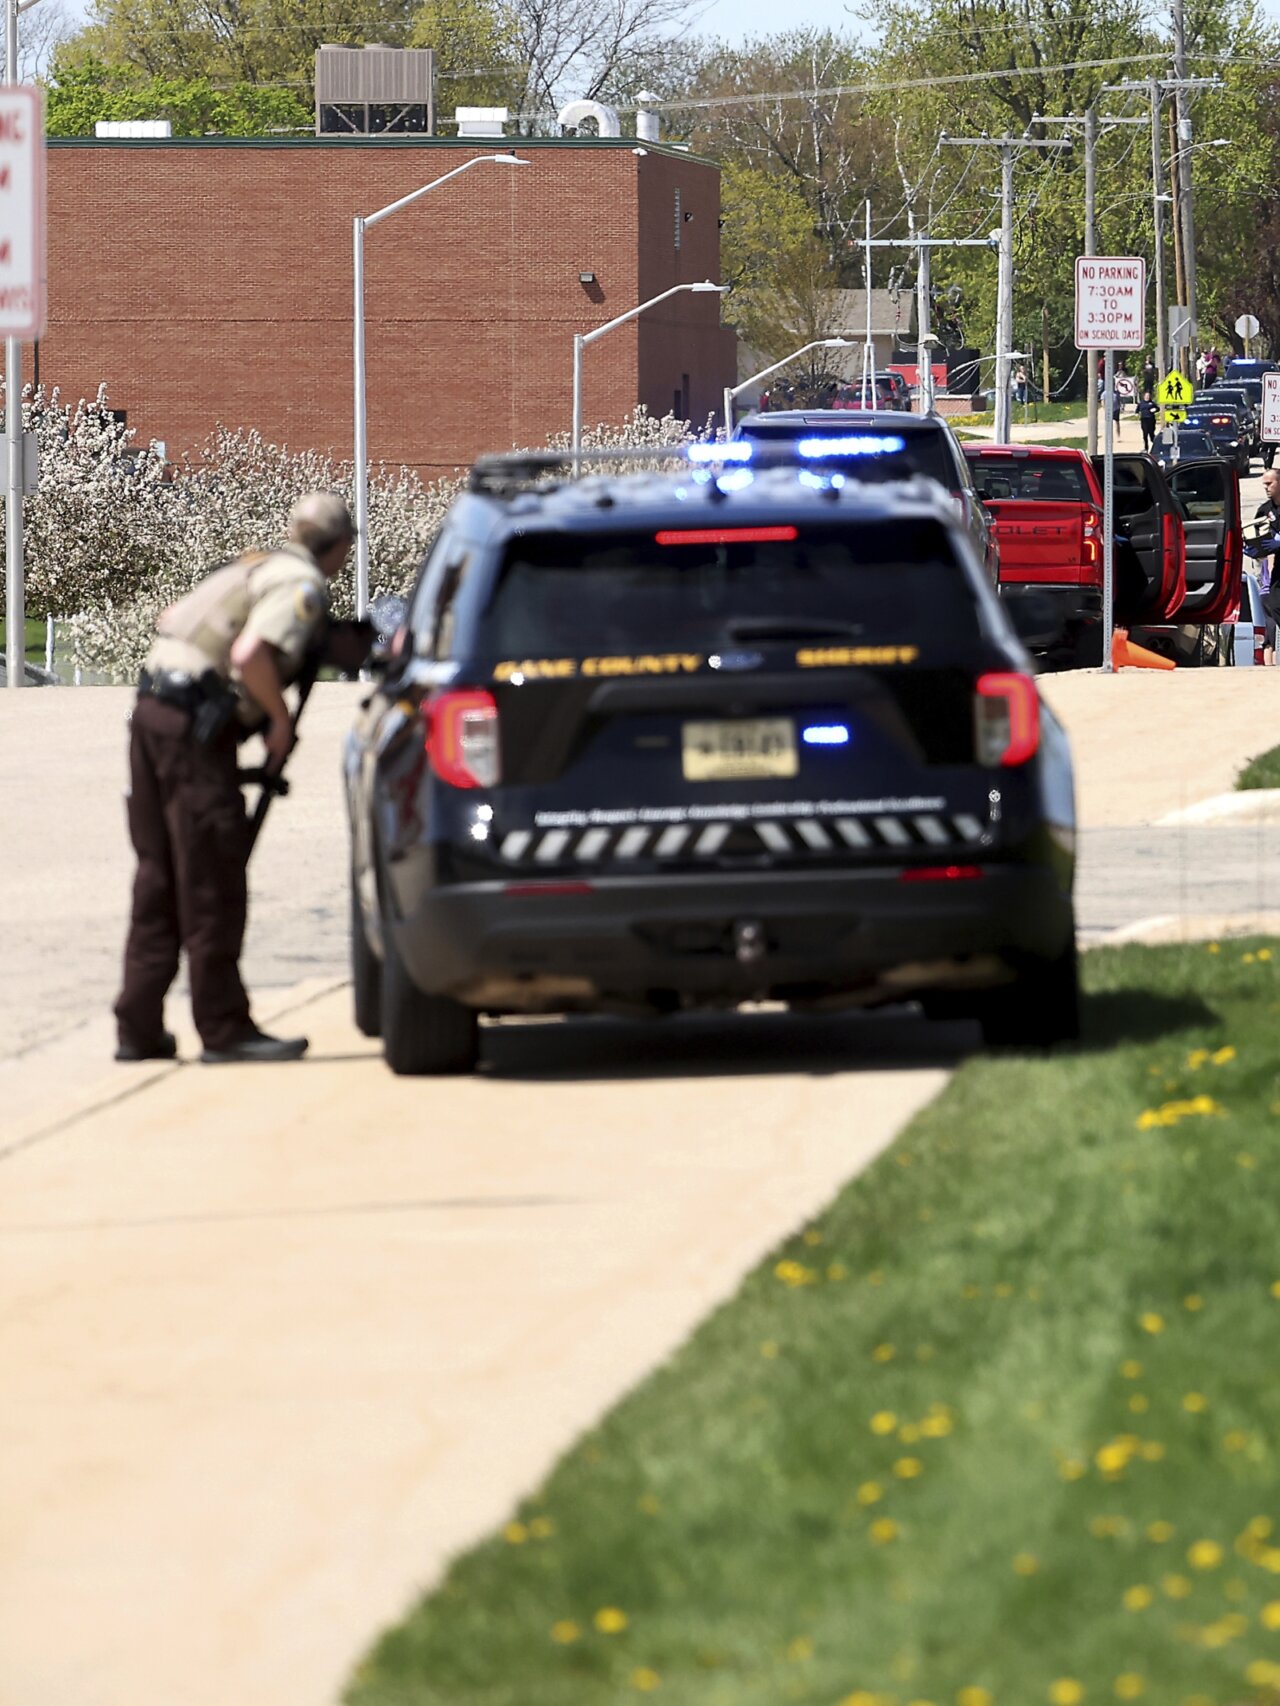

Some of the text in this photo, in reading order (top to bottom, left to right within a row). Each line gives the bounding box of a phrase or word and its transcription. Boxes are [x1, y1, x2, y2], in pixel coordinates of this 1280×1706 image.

[1082, 266, 1139, 280] NO PARKING
[1087, 285, 1133, 297] 7:30AM
[1103, 298, 1118, 310] TO
[1087, 312, 1133, 324] 3:30PM
[1079, 329, 1140, 340] ON SCHOOL DAYS
[1267, 379, 1277, 390] NO
[1264, 427, 1272, 435] ON
[795, 644, 918, 668] SHERIFF
